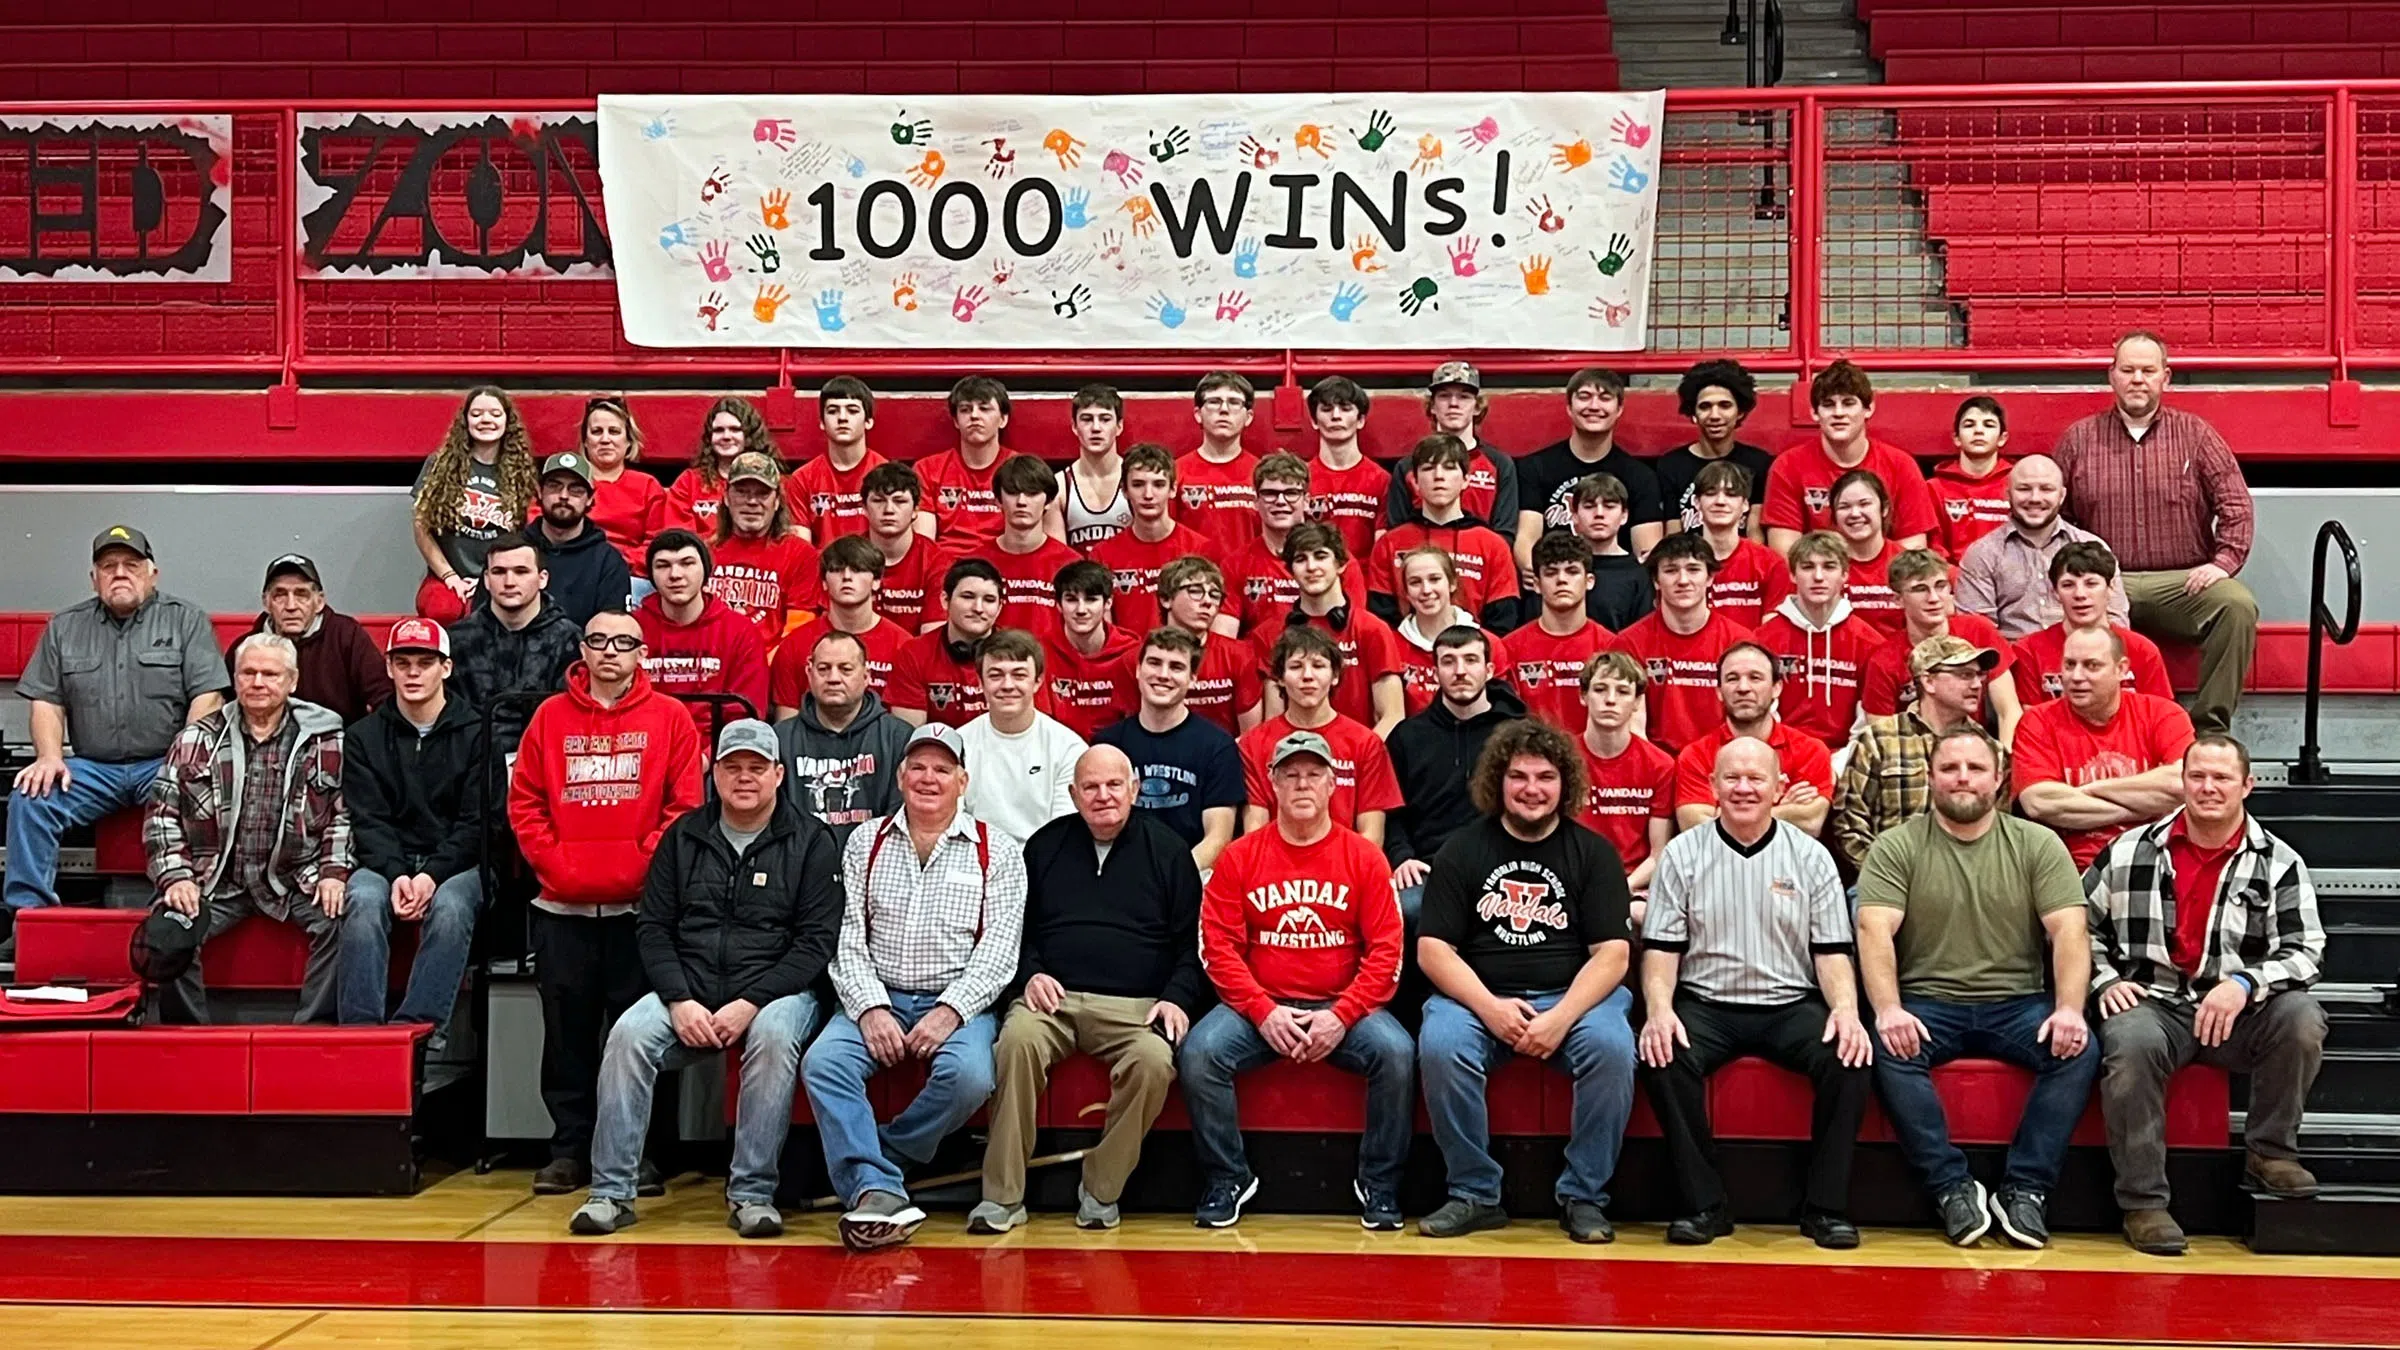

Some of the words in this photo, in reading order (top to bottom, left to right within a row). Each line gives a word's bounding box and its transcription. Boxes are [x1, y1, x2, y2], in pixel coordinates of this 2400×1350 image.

[0, 137, 201, 258] ED
[319, 133, 608, 259] ZON
[808, 178, 1063, 261] 1000
[967, 490, 996, 499] VAND
[1333, 493, 1378, 505] VANDALIA
[1070, 526, 1123, 546] ANDA
[713, 565, 778, 583] ANDALIA
[1553, 662, 1586, 671] VAND
[1672, 661, 1718, 672] VANDAL
[1076, 681, 1114, 691] VANDA
[1598, 806, 1650, 815] WRESTLIN
[1247, 879, 1349, 913] VANDAL
[1476, 891, 1569, 930] Vandals
[1260, 929, 1346, 949] WRESTLING
[1494, 924, 1547, 946] WRESTLING
